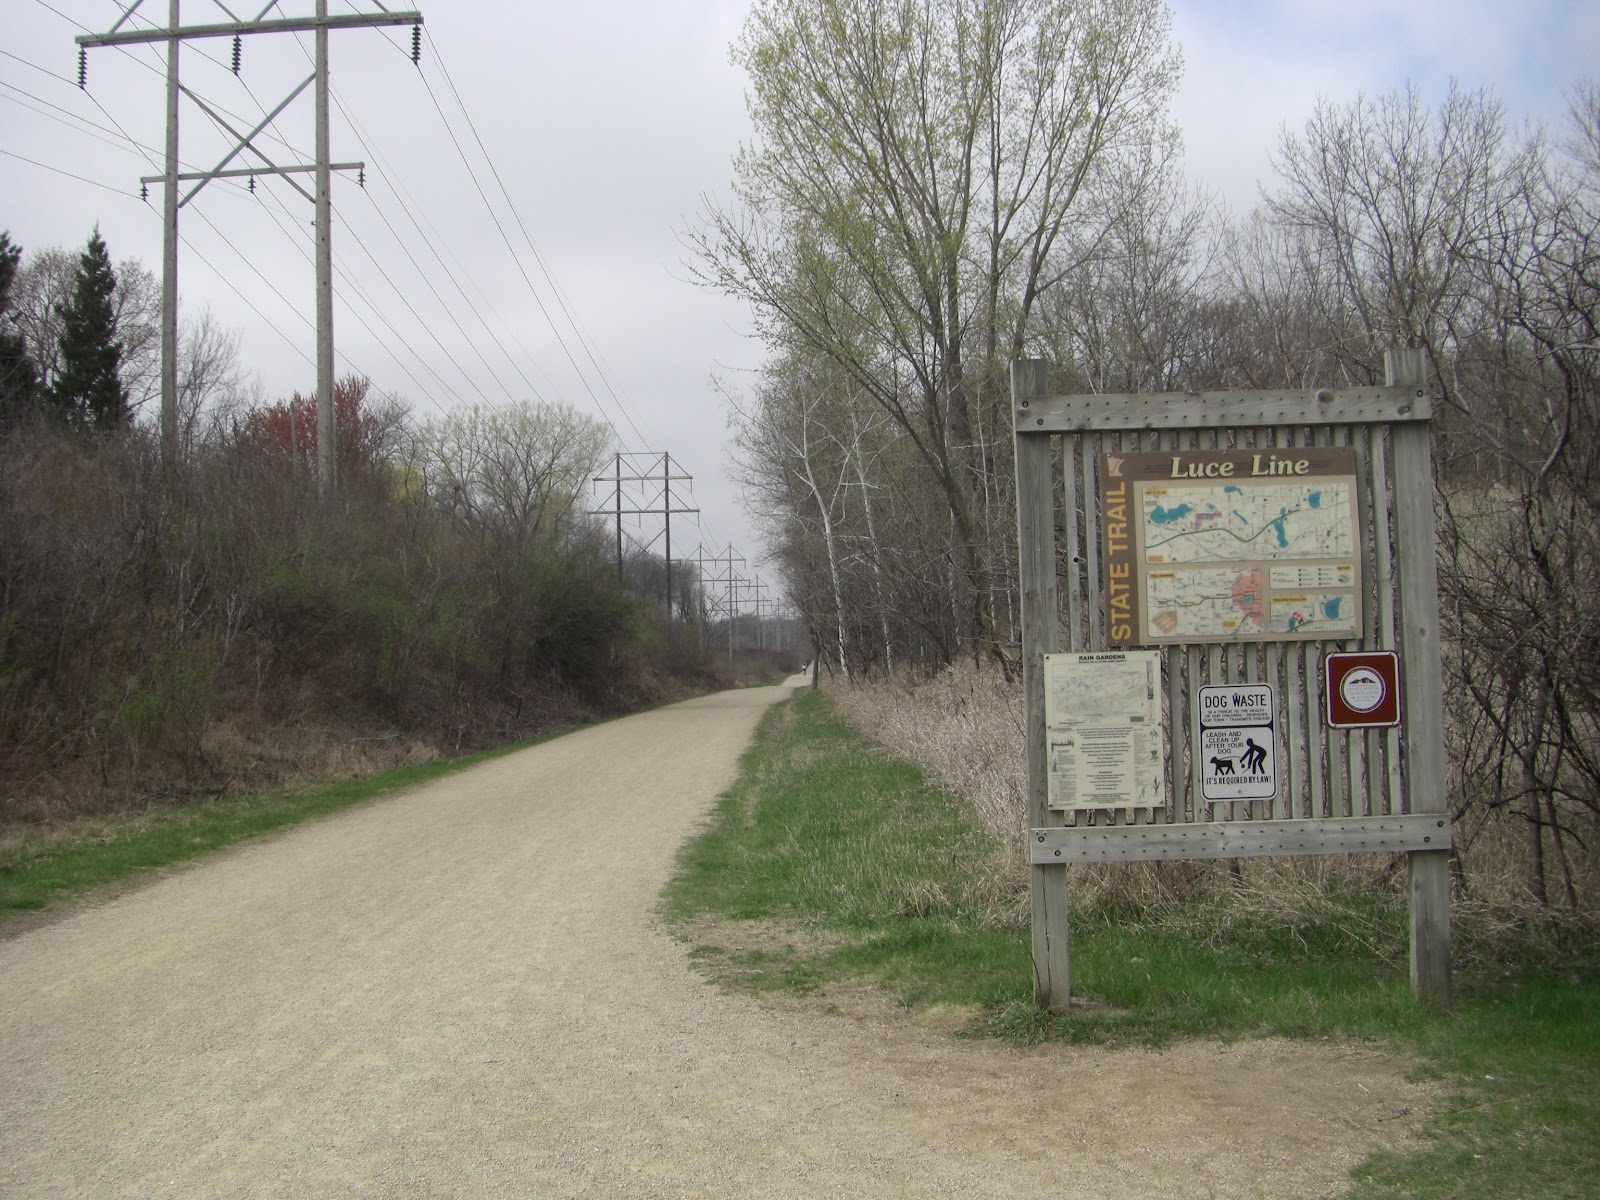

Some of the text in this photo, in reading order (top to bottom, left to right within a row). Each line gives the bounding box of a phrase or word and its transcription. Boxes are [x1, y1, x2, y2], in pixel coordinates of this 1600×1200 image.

[1170, 454, 1310, 478] Luce Line
[1105, 481, 1132, 641] STATE TRAIL
[1205, 694, 1267, 708] DOG WASTE
[1206, 777, 1218, 785] IT'S
[1218, 776, 1248, 785] REQUIRED
[1248, 776, 1256, 784] BY
